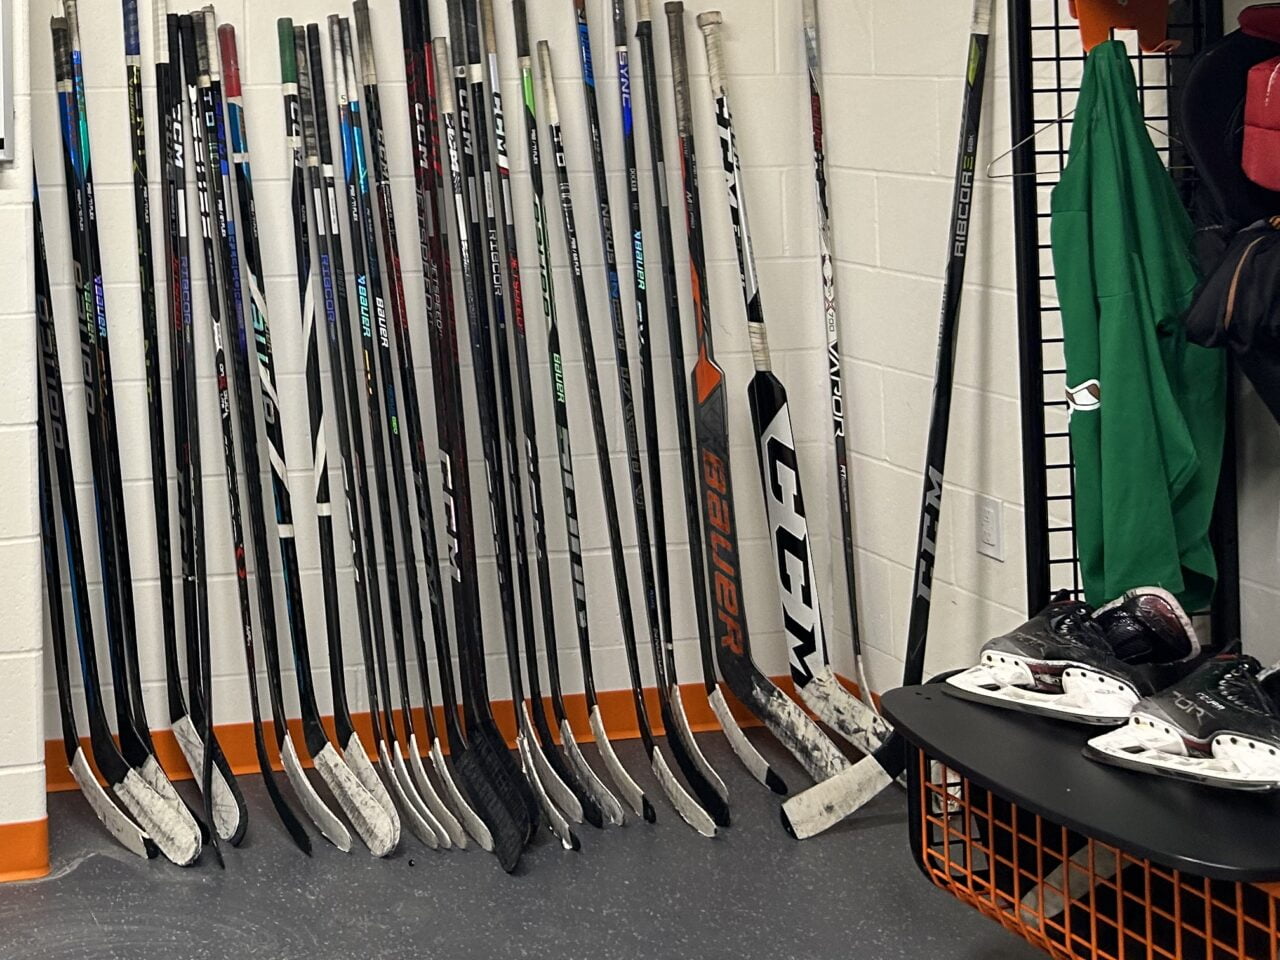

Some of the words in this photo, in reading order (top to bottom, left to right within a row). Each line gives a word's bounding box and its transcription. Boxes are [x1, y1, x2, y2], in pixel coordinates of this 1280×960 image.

[414, 103, 428, 169] CCM
[459, 89, 473, 155] CCM
[634, 240, 646, 290] BAUER
[359, 285, 371, 337] BAUER
[375, 297, 389, 348] BAUER
[553, 353, 565, 402] BAUER
[829, 341, 845, 438] VAPOR
[702, 448, 744, 656] BAUER
[766, 436, 817, 689] CCM
